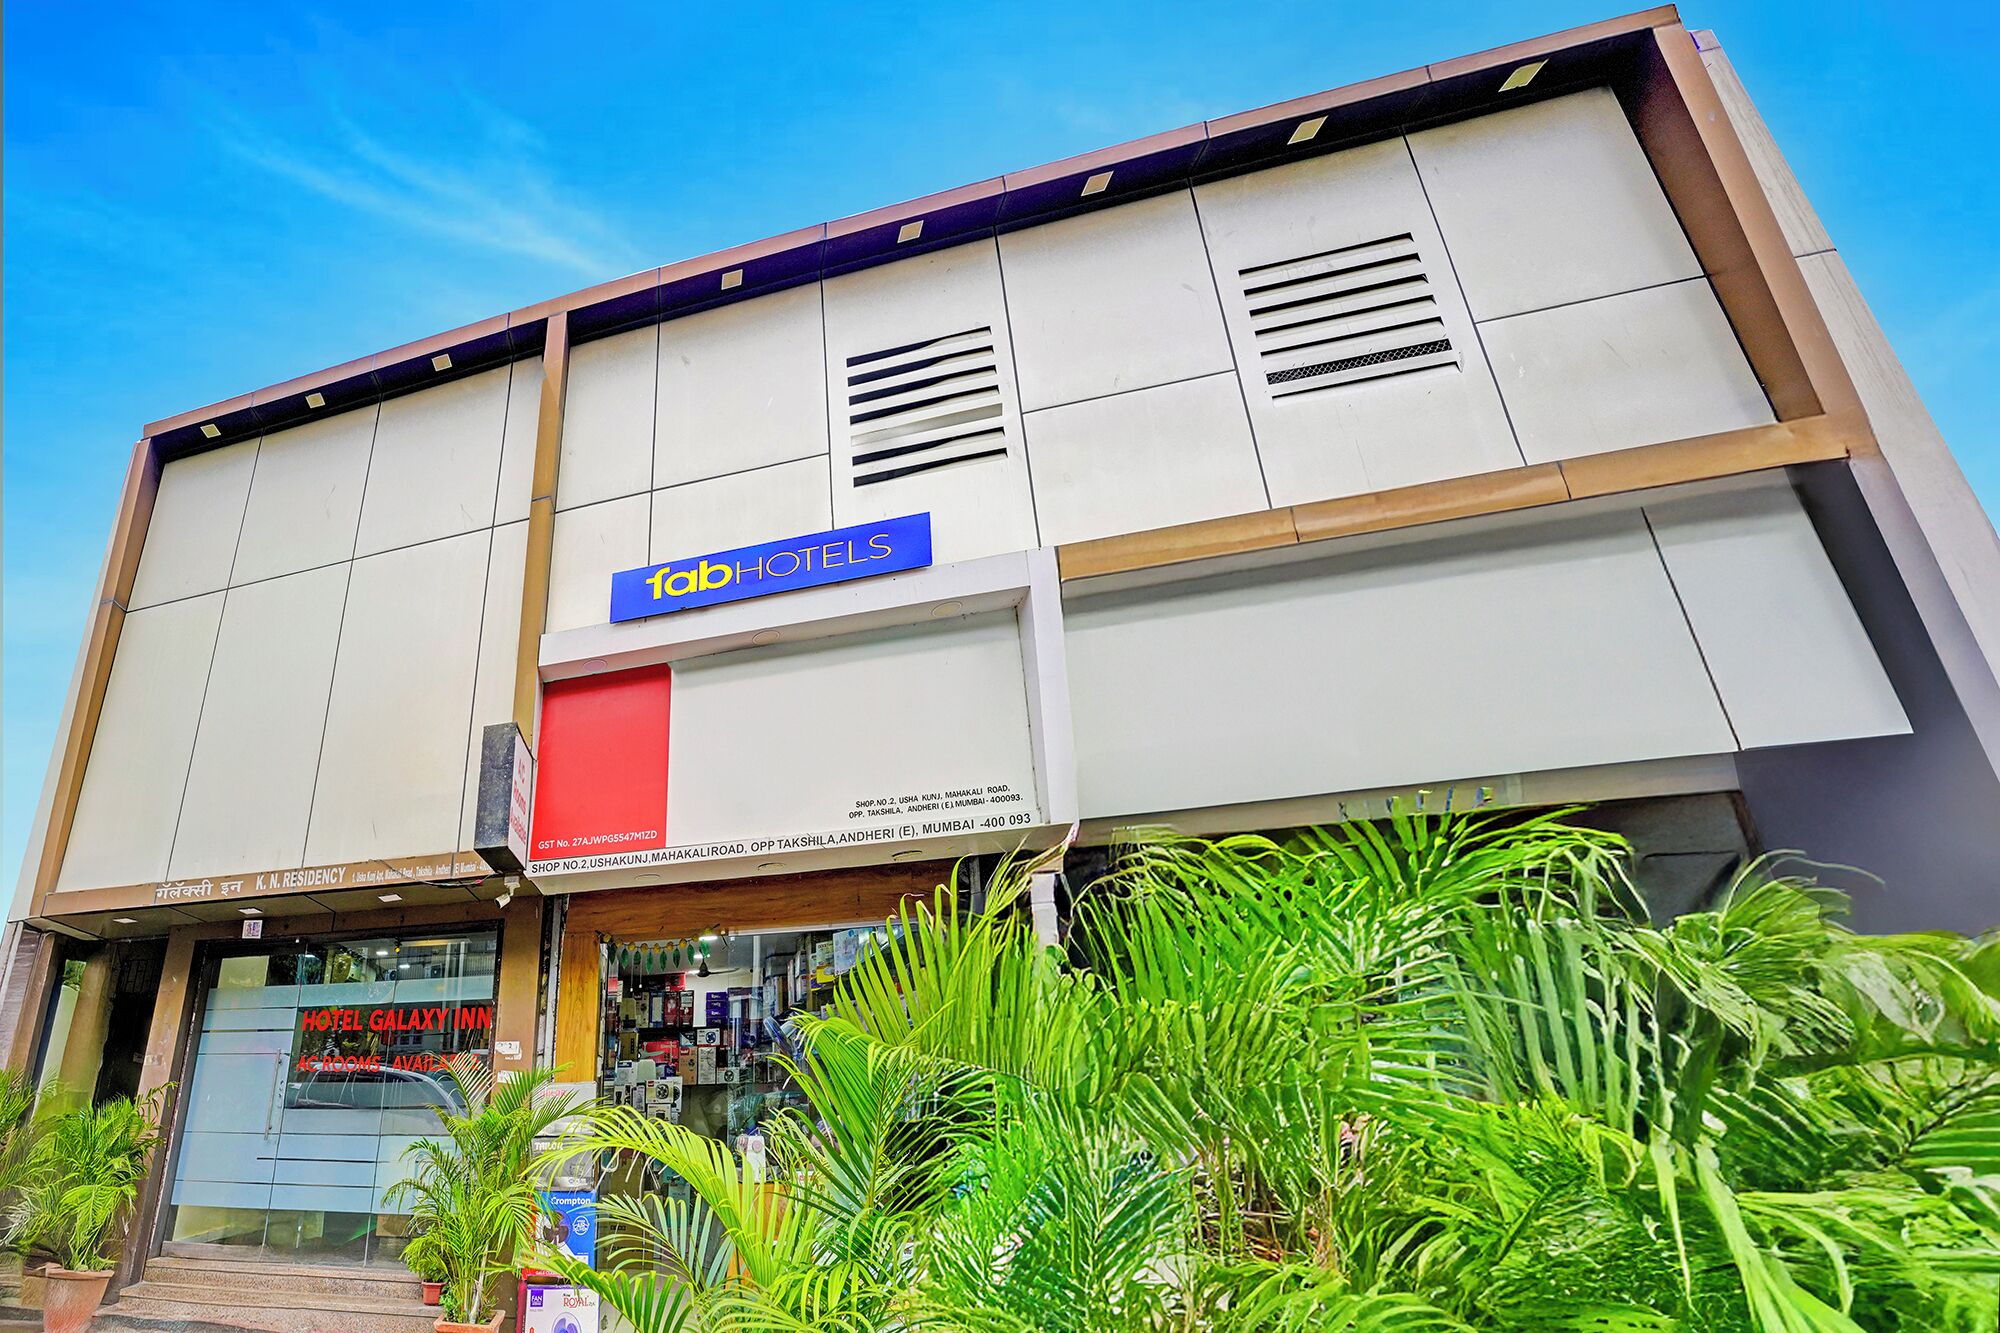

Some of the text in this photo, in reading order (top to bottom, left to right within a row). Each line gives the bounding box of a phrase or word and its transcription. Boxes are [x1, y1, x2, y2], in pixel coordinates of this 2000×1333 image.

[645, 533, 893, 600] fabHOTELS
[898, 795, 919, 805] USHA
[945, 787, 983, 799] MAHAKALI
[907, 802, 939, 813] ANDHERI
[531, 862, 560, 874] SHOP
[750, 841, 775, 852] OPP
[922, 819, 975, 836] MUMBAI
[1008, 813, 1031, 826] 093
[538, 840, 555, 850] GST
[556, 838, 571, 848] No.
[282, 867, 346, 888] RESIDENCY
[219, 880, 244, 897] इन
[302, 1007, 492, 1031] HOTEL GALAXY INN
[297, 1056, 318, 1072] AC
[321, 1055, 381, 1073] ROOMS
[551, 1196, 591, 1206] Crompton
